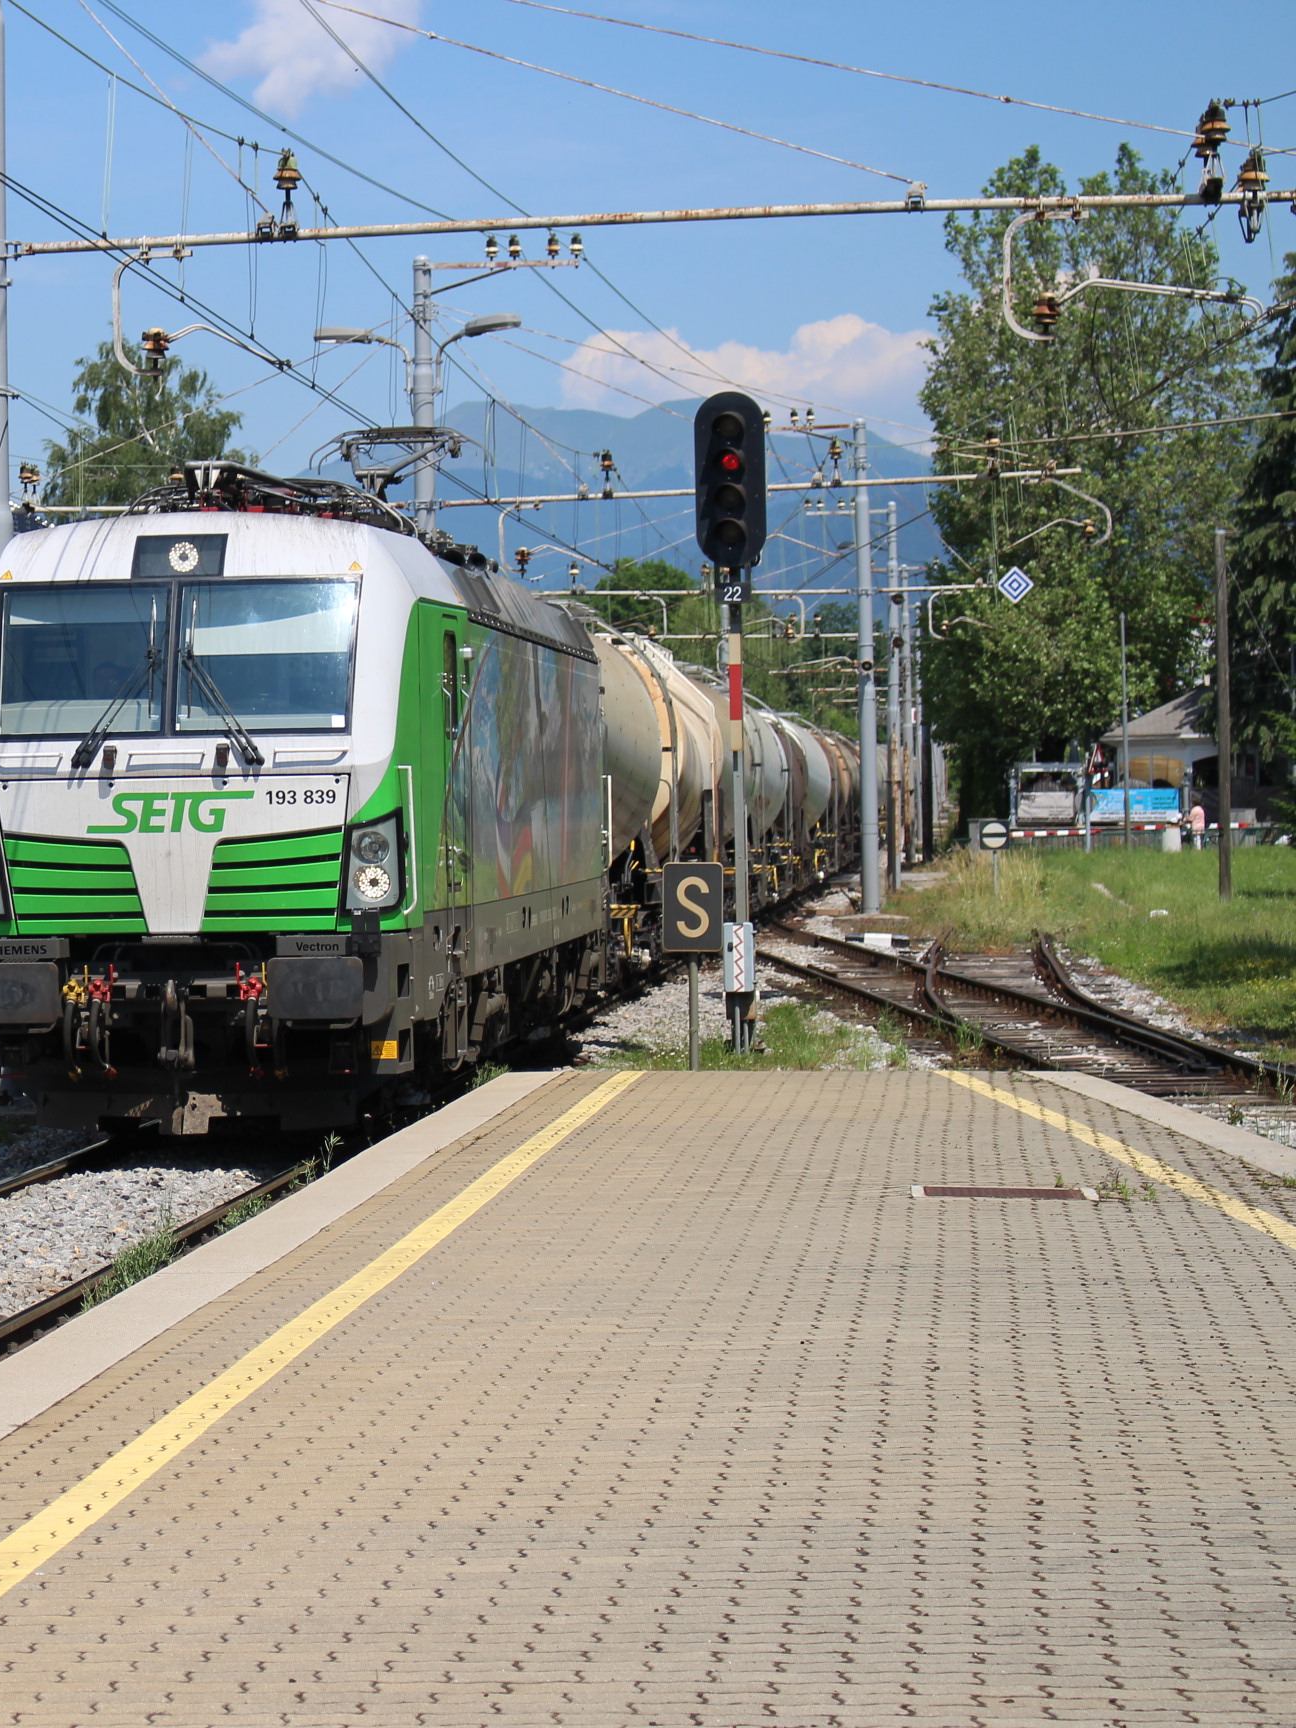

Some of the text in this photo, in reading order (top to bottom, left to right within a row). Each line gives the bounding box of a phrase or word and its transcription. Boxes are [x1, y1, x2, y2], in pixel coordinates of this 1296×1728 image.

[724, 586, 742, 602] 22
[265, 789, 336, 805] 193 839
[86, 790, 255, 834] SETG
[676, 876, 710, 938] S
[295, 942, 340, 952] Vectron
